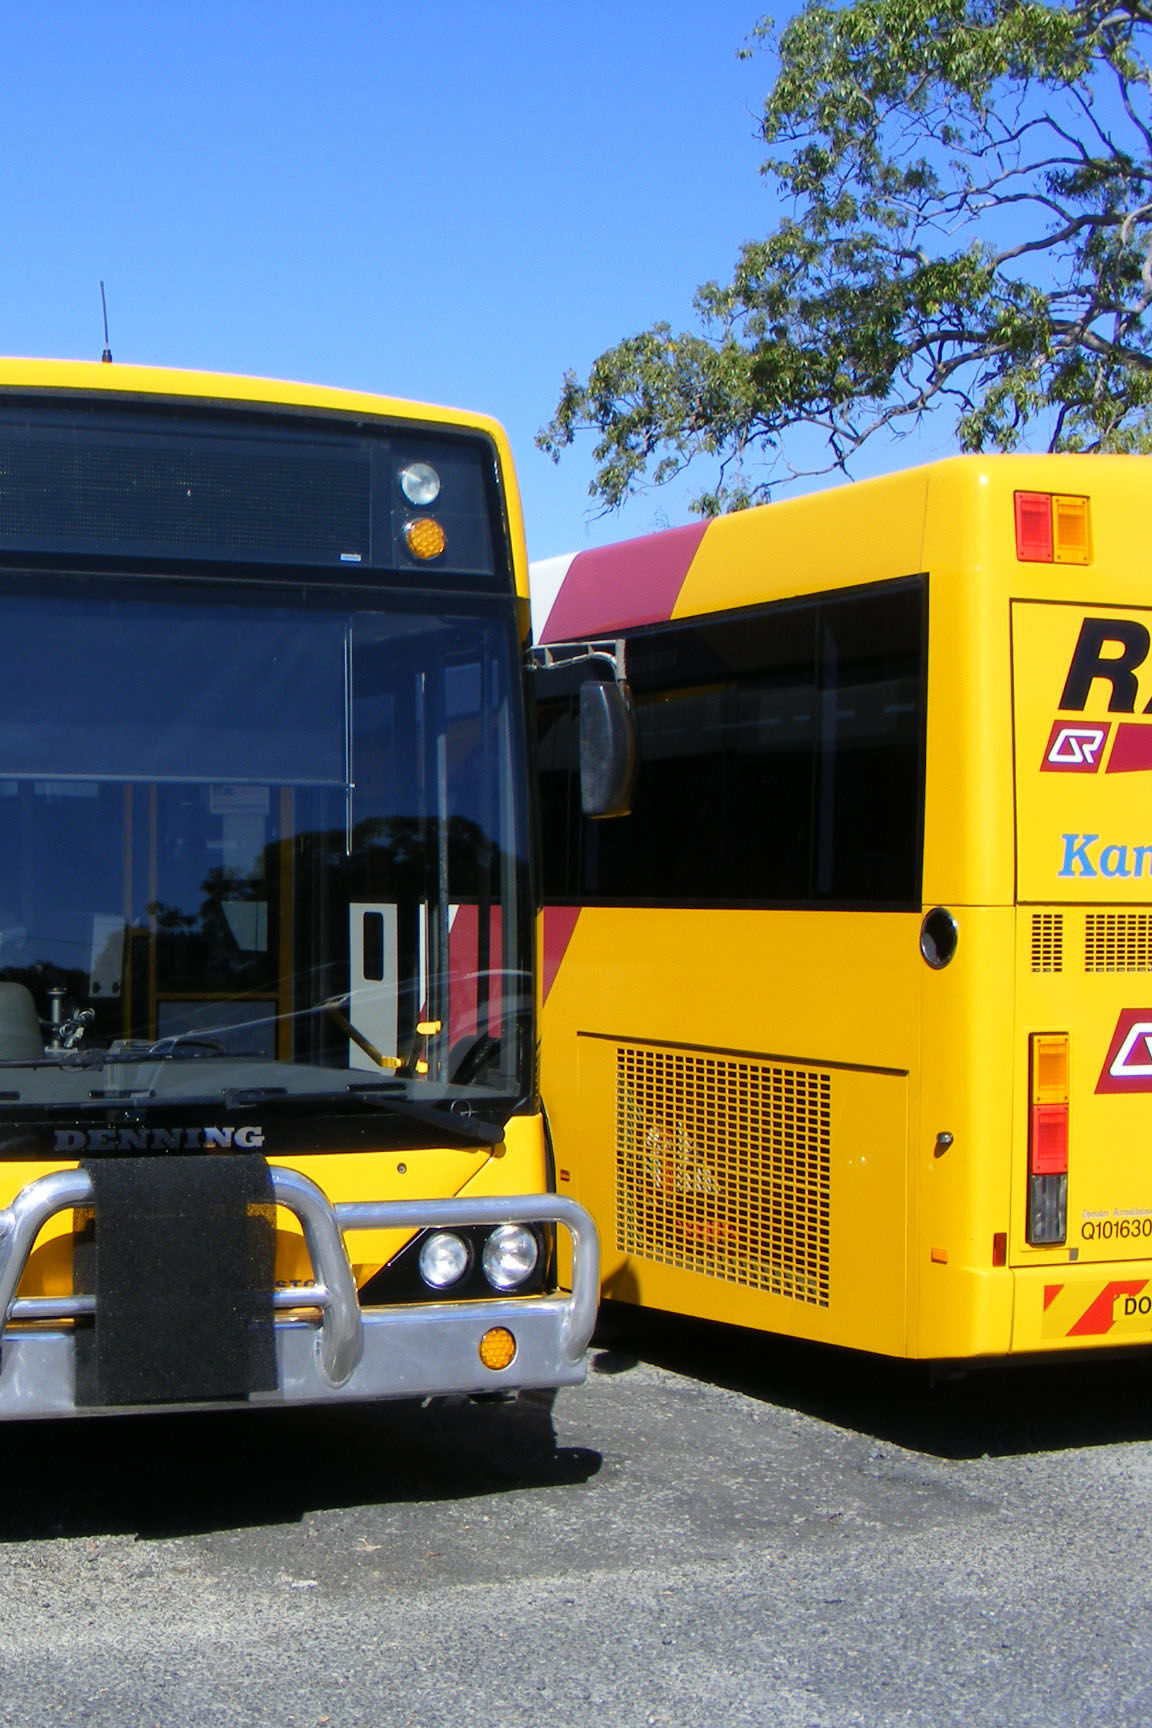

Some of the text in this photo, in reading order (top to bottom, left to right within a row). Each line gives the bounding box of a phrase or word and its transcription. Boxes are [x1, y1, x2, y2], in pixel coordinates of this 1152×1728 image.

[1058, 617, 1152, 715] R
[54, 1126, 264, 1150] DENNING
[1081, 1218, 1152, 1241] Q101630
[1124, 1295, 1152, 1316] DO
